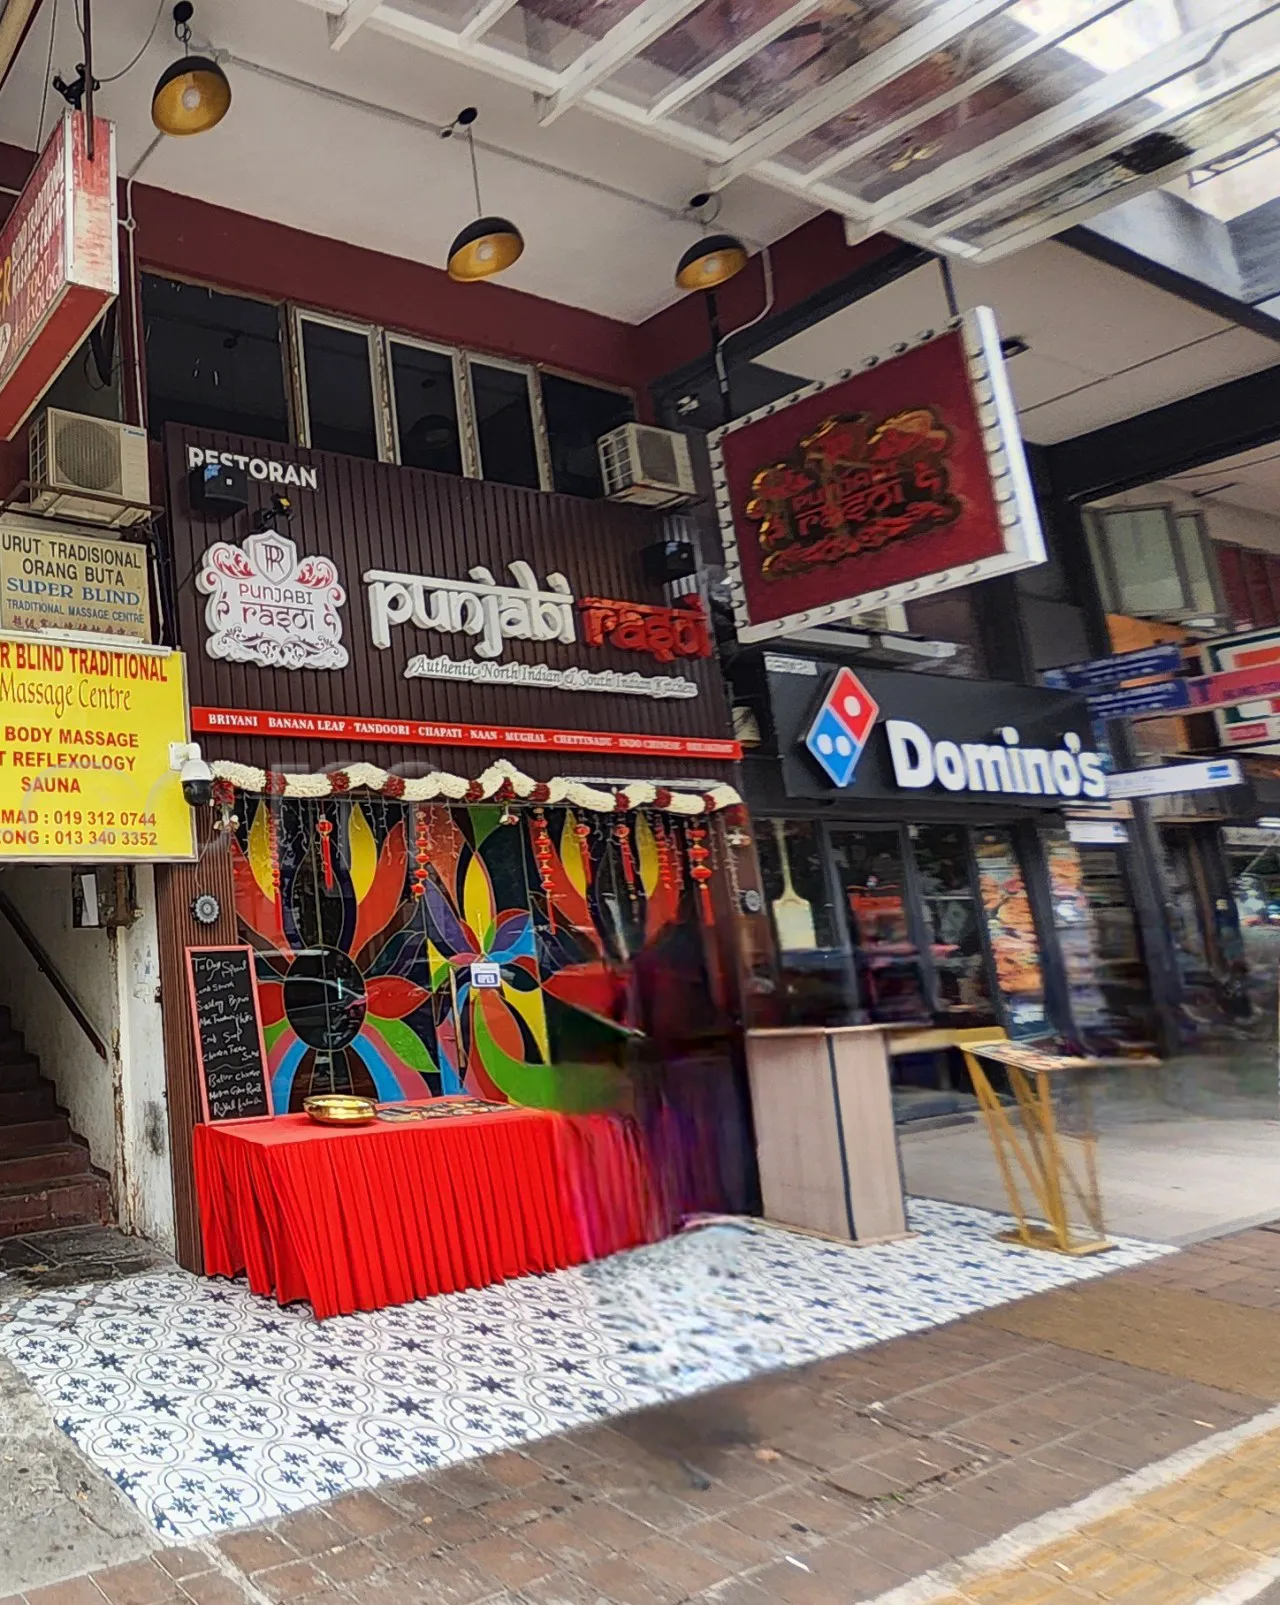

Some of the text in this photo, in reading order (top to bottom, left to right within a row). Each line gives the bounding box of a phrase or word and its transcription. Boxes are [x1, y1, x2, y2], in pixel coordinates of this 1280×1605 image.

[188, 446, 318, 489] RESTORAN
[2, 533, 142, 569] URUT TRADISIONAL
[22, 558, 125, 587] ORANG BUTA
[7, 577, 140, 606] SUPER BLIND
[7, 598, 145, 624] TRADITIONAL MASSAGE CENTRE
[364, 560, 575, 658] punjabi
[16, 643, 63, 672] BLIND
[69, 648, 168, 682] TRADITIONAL
[415, 655, 479, 677] Authentic
[481, 663, 519, 681] North
[522, 667, 561, 684] Indian
[579, 671, 613, 687] South
[0, 672, 131, 718] Massage Centre
[5, 726, 53, 744] BODY
[59, 729, 139, 748] MASSAGE
[208, 713, 258, 727] BRIYANI
[268, 717, 314, 731] BANANA
[317, 720, 346, 732] LEAF
[354, 722, 409, 736] TANDOORI
[418, 727, 462, 739] CHAPATI
[470, 730, 497, 740] NAAN
[504, 732, 547, 743] MUGHAL
[13, 752, 136, 771] REFLEXOLOGY
[886, 720, 1107, 799] Domino's
[21, 777, 81, 793] SAUNA
[54, 811, 82, 825] 019
[87, 811, 115, 825] 312
[121, 812, 157, 826] 0744
[55, 831, 83, 845] 013
[89, 832, 116, 845] 340
[122, 832, 158, 846] 3352
